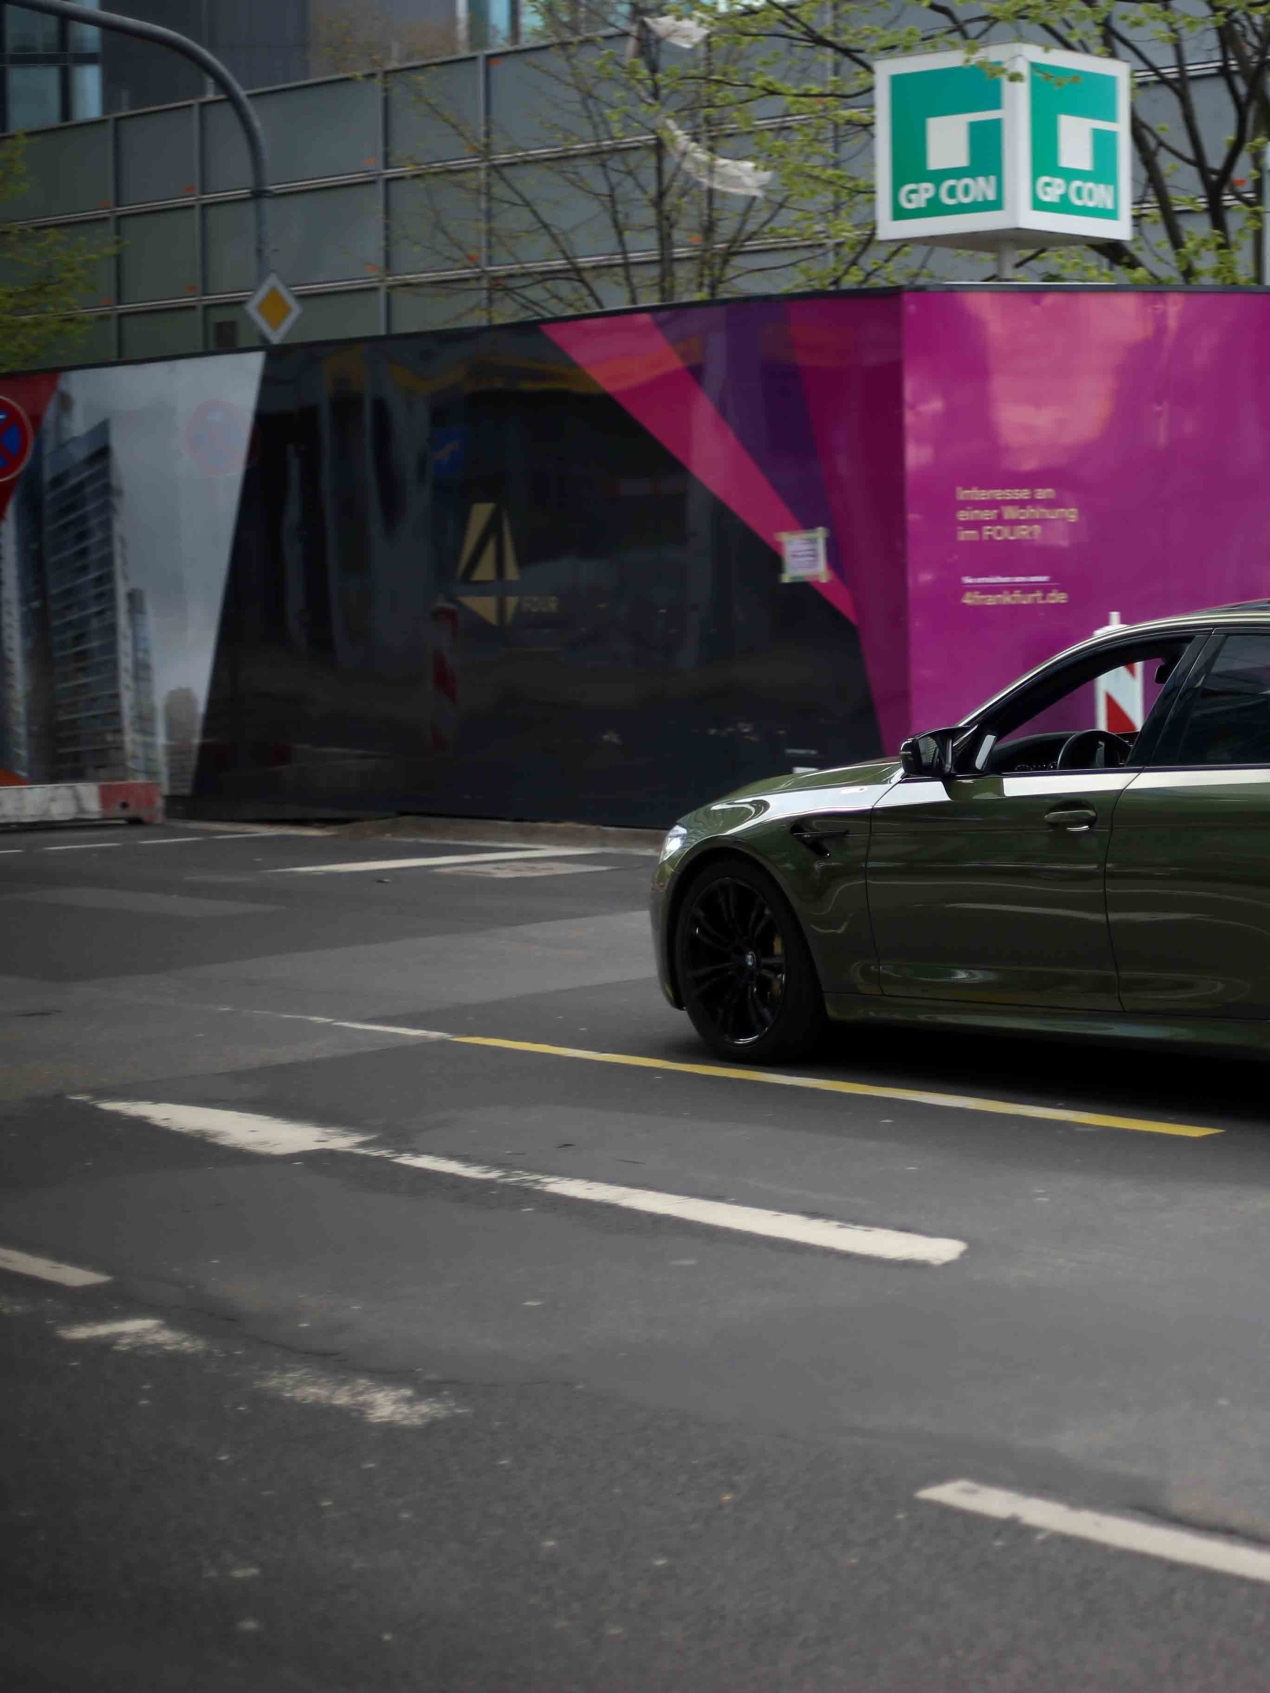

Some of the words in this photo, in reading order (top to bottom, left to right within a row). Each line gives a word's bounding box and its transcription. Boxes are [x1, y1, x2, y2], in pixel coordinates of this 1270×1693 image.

[898, 182, 936, 209] GP
[938, 175, 998, 206] CON
[1035, 175, 1067, 203] GP
[1068, 180, 1115, 209] CON
[956, 487, 1031, 501] Interesse
[1034, 488, 1056, 500] an
[956, 507, 998, 521] einer
[1001, 506, 1079, 522] Wohnung
[957, 527, 980, 541] im
[982, 525, 1042, 541] FOUR?
[961, 590, 1069, 606] 4frankfurt.de
